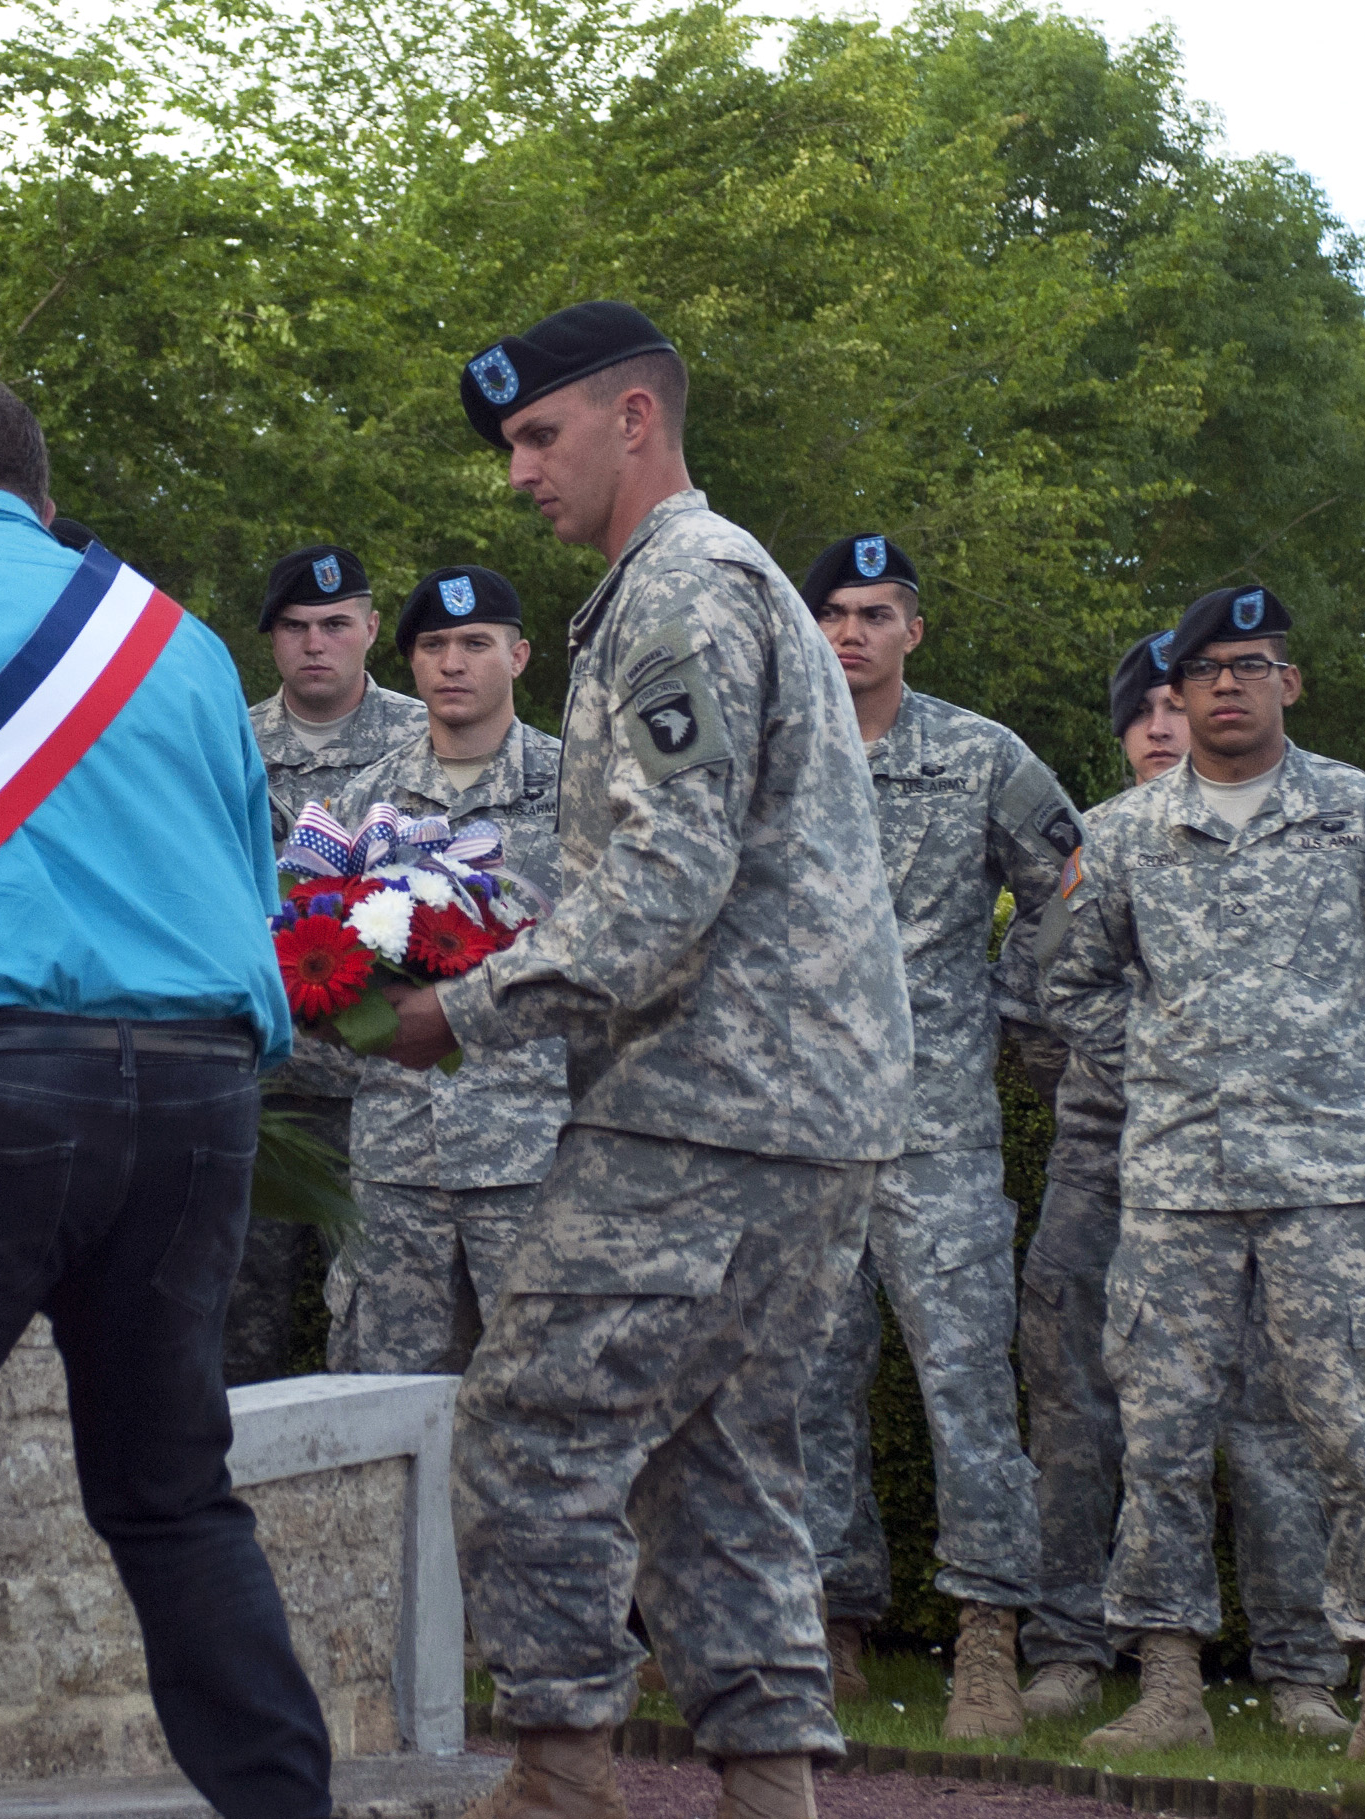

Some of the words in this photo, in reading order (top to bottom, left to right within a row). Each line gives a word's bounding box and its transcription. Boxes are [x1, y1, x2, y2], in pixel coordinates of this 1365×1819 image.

[637, 680, 681, 707] AIRBORNE
[928, 777, 968, 793] ARMY
[528, 802, 557, 816] ARM
